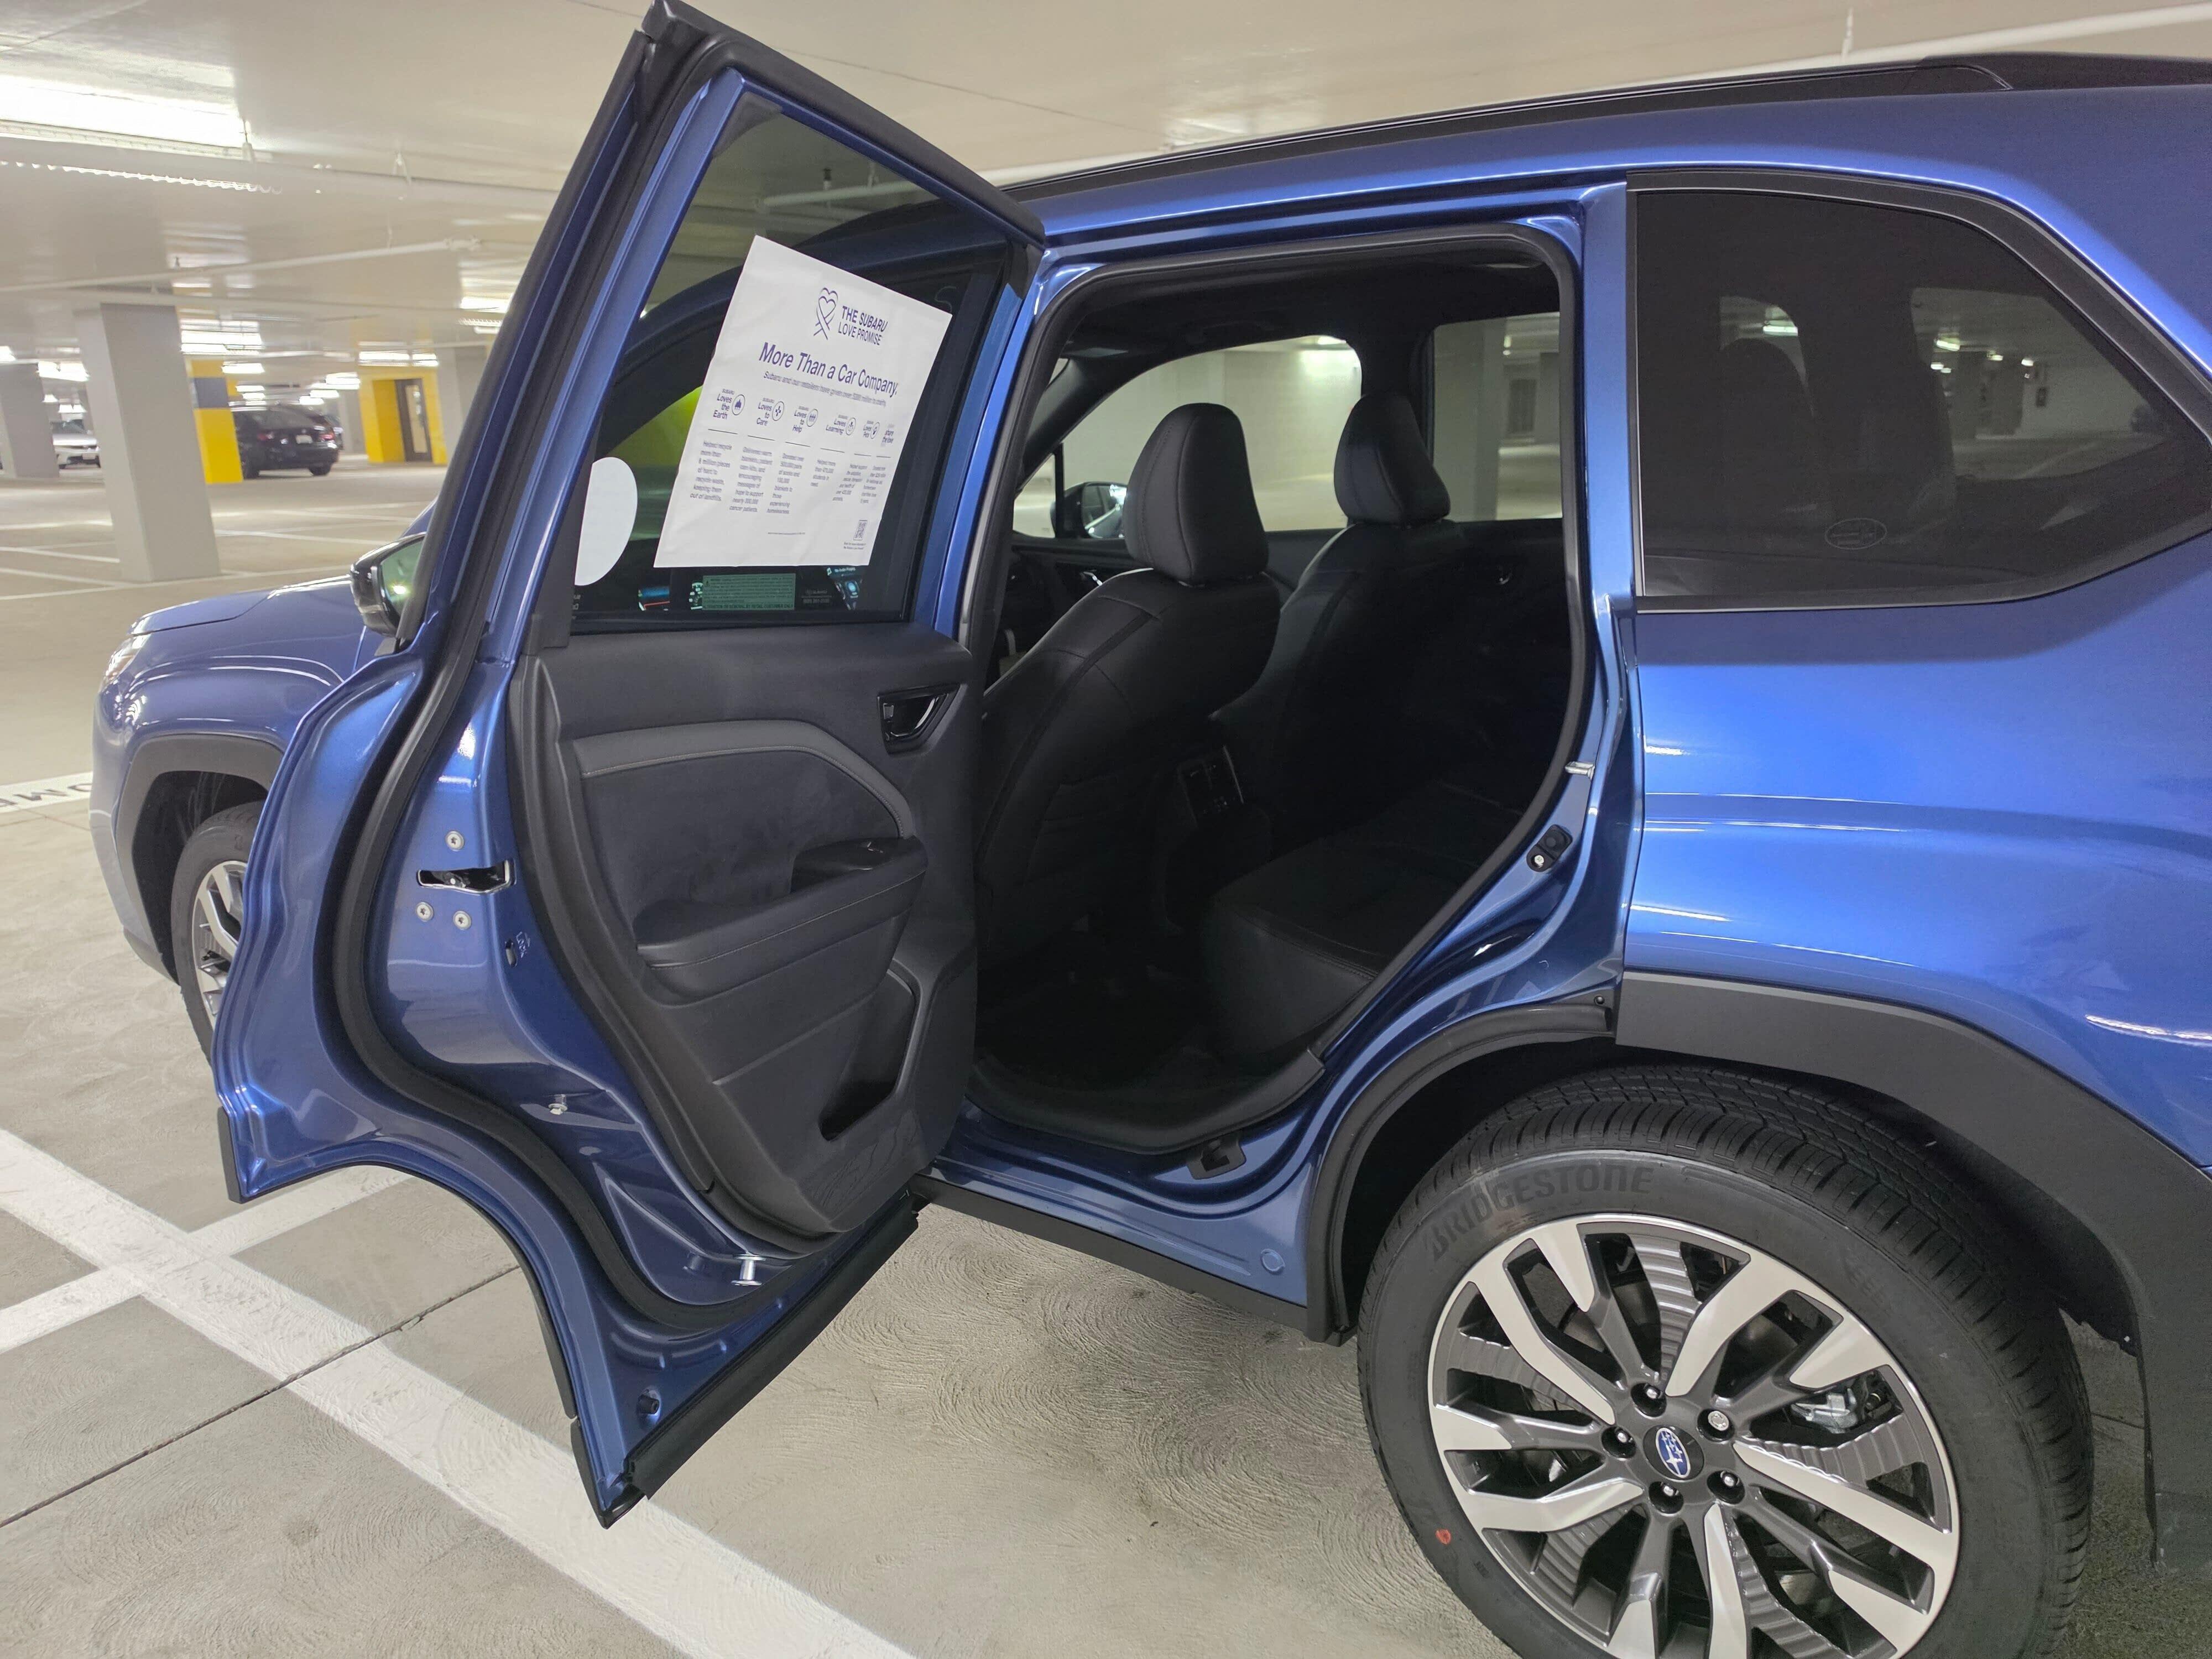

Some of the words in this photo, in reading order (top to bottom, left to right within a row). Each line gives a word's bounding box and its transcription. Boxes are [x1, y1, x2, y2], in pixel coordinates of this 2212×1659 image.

[842, 306, 858, 323] THE
[859, 312, 888, 332] SUBARU
[838, 322, 857, 338] LOVE
[857, 328, 882, 345] PROMISE
[759, 342, 794, 368] More
[797, 352, 826, 377] Than
[827, 366, 836, 379] a
[838, 364, 857, 384] Car
[858, 369, 899, 398] Company.
[717, 394, 733, 403] Loves
[721, 403, 730, 411] the
[758, 402, 773, 411] Loves
[713, 410, 728, 420] Earth
[794, 410, 807, 419] Loves
[756, 418, 768, 426] Care
[834, 419, 847, 427] Loves
[792, 425, 802, 434] Help
[826, 425, 844, 435] Learning
[1425, 1164, 1654, 1262] BRIDGESTONE
